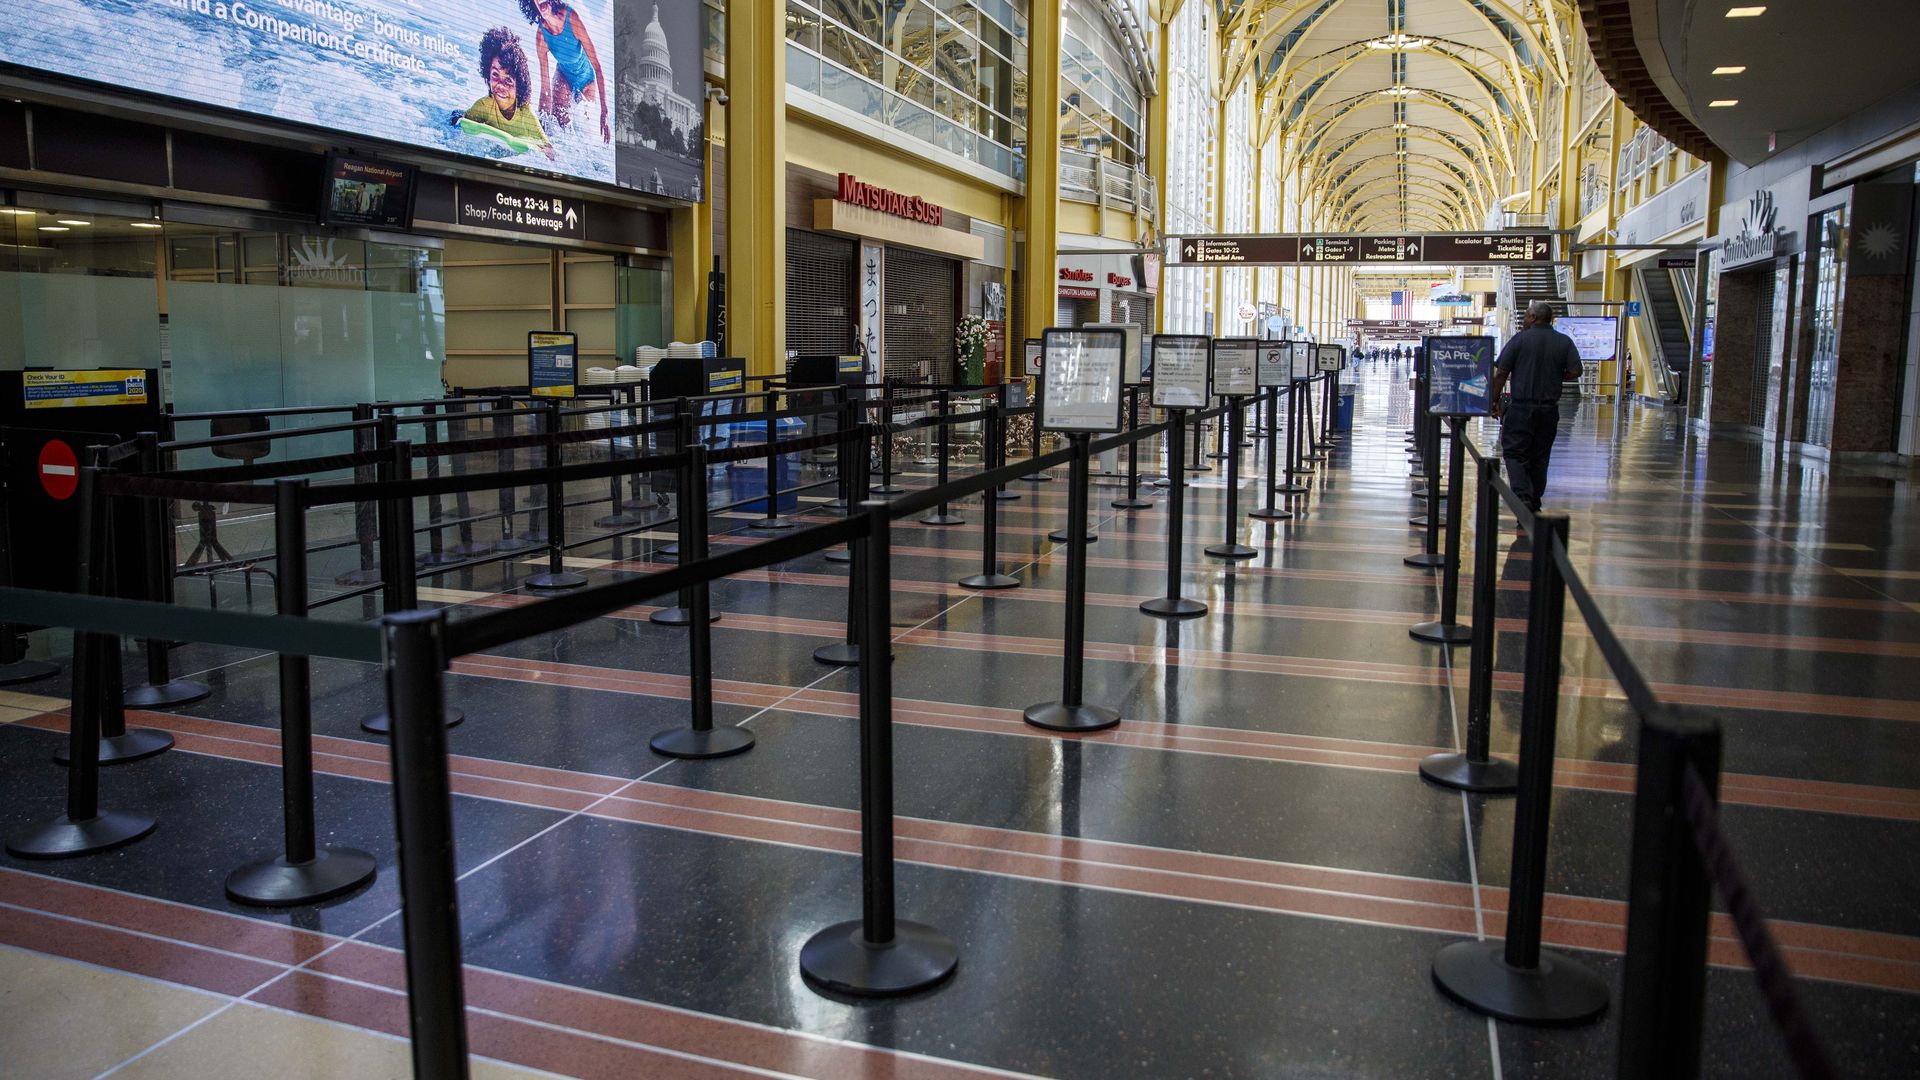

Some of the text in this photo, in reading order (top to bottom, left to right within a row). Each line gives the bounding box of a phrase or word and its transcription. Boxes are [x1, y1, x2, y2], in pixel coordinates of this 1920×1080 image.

[214, 2, 228, 20] a
[231, 3, 340, 49] Companion
[373, 14, 421, 46] bonus
[422, 31, 461, 57] miles
[343, 162, 403, 178] Reagan National Airport
[496, 192, 549, 212] Gates 23-34
[839, 173, 944, 226] MATSUTAKE SUSHI
[464, 204, 563, 231] Shop/Food & Beverage
[1060, 267, 1093, 281] Smokes
[1109, 272, 1131, 287] Burgers
[1058, 288, 1076, 296] SHINGTON
[1433, 350, 1470, 360] TSA Pre
